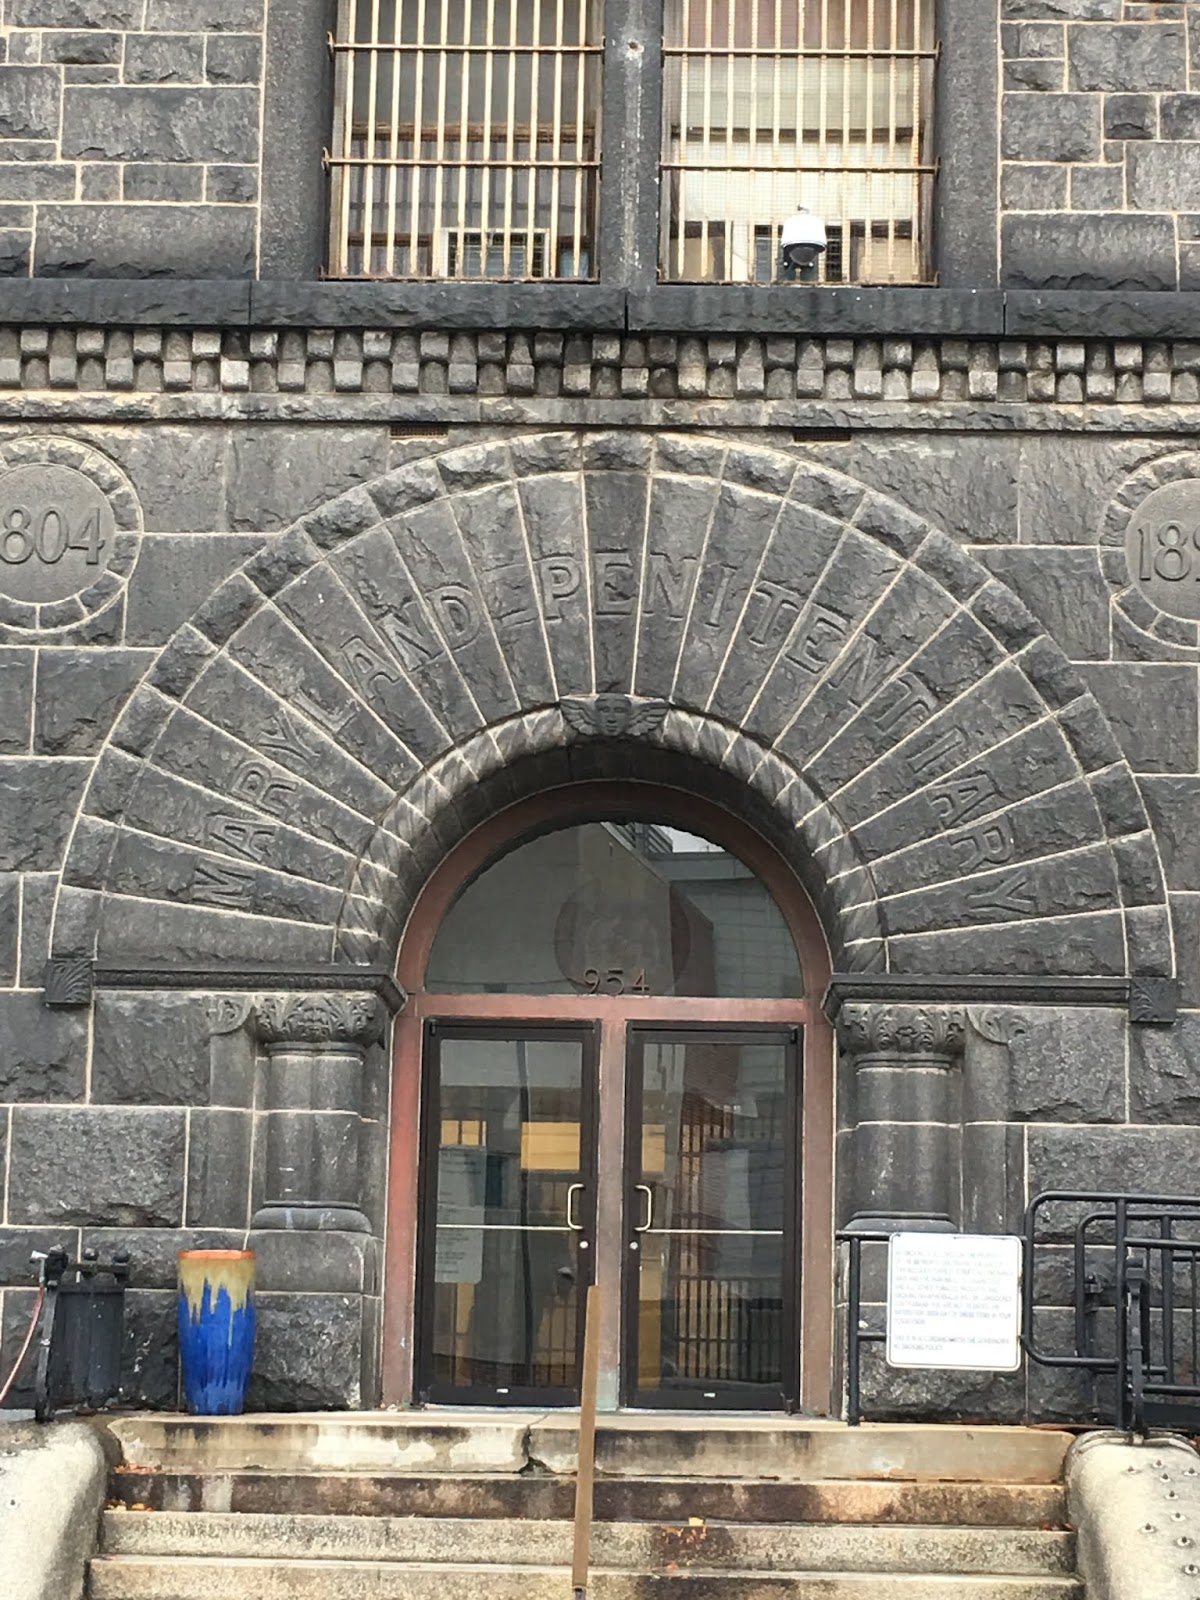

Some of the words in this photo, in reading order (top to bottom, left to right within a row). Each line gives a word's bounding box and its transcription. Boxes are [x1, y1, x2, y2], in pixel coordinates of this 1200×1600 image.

[193, 581, 481, 908] MARYLAND
[540, 550, 1038, 915] PENITENTIARY
[584, 968, 650, 997] 954
